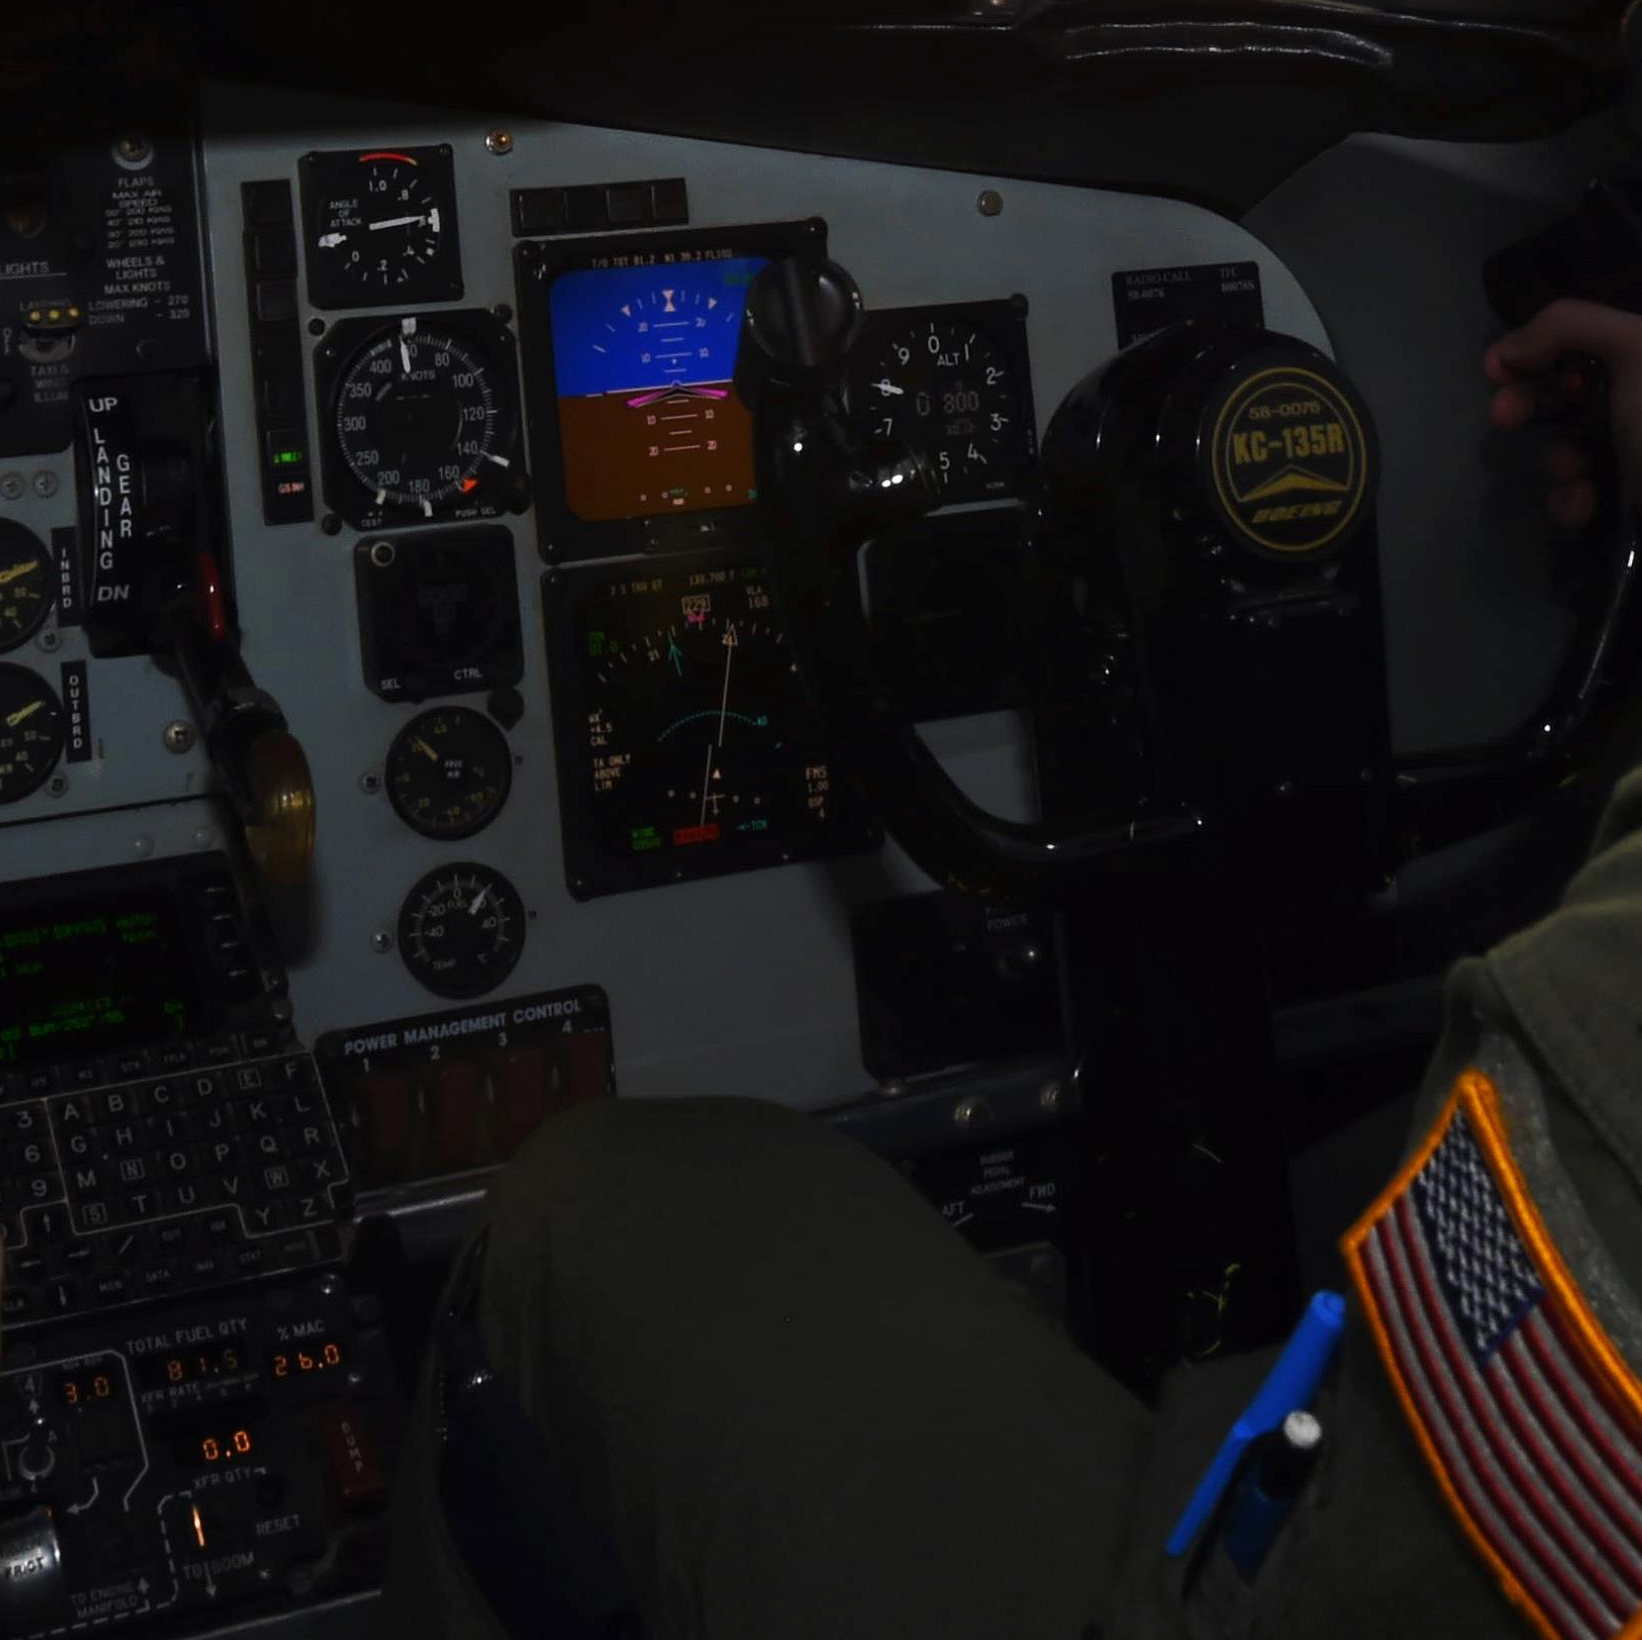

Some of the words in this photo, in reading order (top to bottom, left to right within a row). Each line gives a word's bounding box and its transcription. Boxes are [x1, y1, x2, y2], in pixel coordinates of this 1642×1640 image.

[329, 199, 359, 210] ANGLE
[338, 208, 351, 218] OF
[329, 216, 362, 227] ATTACK
[104, 283, 131, 295] MAX
[936, 351, 960, 367] ALT
[88, 396, 118, 414] UP
[1233, 423, 1347, 465] KC-135R
[93, 427, 114, 571] LANDING
[116, 453, 132, 538] GEAR
[61, 547, 72, 609] INBRD
[96, 584, 131, 602] DN
[454, 666, 484, 680] CTRL
[380, 678, 401, 690] SEL
[68, 674, 83, 750] OUTBRD
[344, 1032, 397, 1055] POWER
[404, 1011, 507, 1045] MANAGEMENT
[513, 998, 582, 1024] CONTROL
[125, 1336, 172, 1355] TOTAL
[175, 1326, 213, 1345] FUEL
[219, 1317, 248, 1337] QTY
[293, 1319, 326, 1339] MAC
[255, 1513, 302, 1537] RESET
